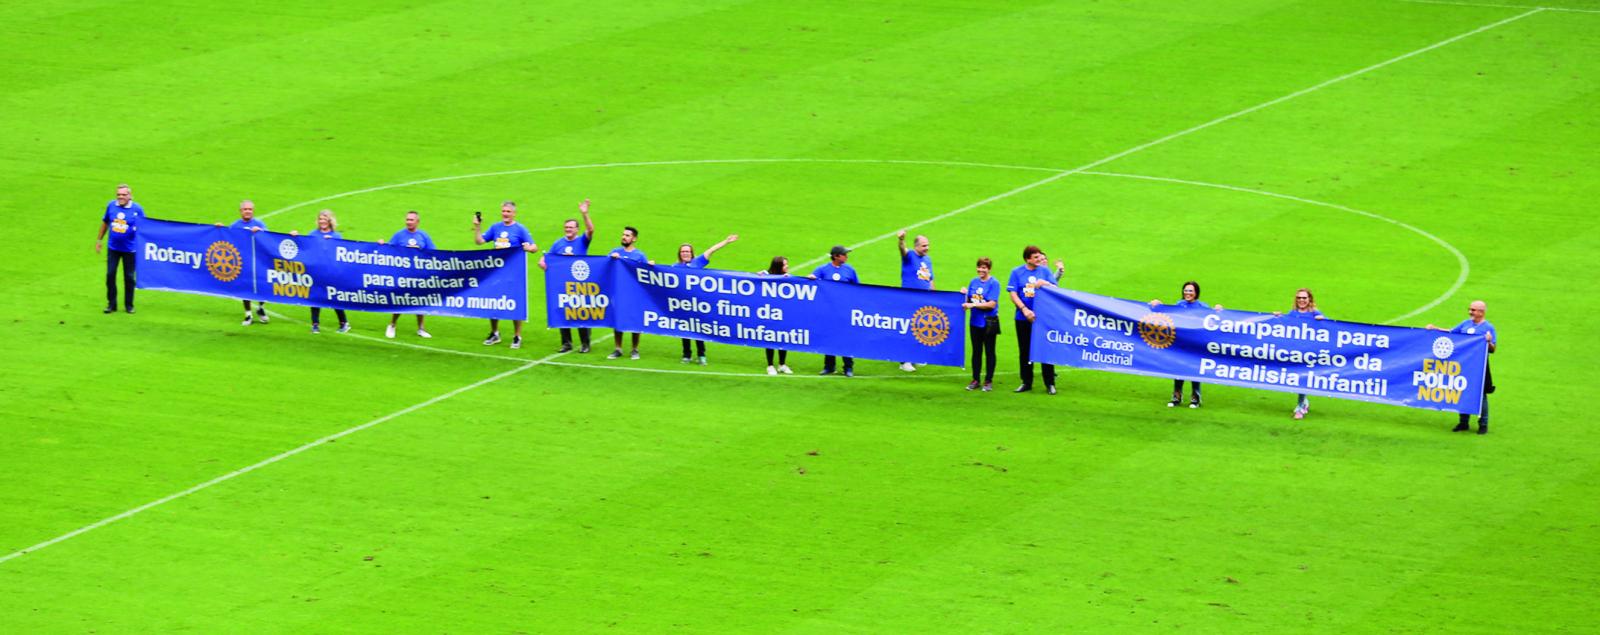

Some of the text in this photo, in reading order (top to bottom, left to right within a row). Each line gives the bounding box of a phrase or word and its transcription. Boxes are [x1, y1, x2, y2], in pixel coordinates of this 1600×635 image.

[145, 242, 202, 269] Rotary
[273, 258, 305, 275] END
[336, 246, 504, 271] Rotarianos trabalhando
[266, 269, 313, 287] POLIO
[363, 273, 478, 289] para erradicar a
[565, 281, 600, 296] END
[636, 268, 817, 300] END POLIO NOW
[272, 283, 310, 299] NOW
[326, 286, 516, 311] Paralisia Infantil no mundo
[558, 293, 609, 308] POLIO
[565, 307, 605, 320] NOW
[668, 296, 783, 321] pelo fim da
[643, 311, 810, 346] Paralisia Infantil
[851, 309, 910, 335] Rotary
[1074, 308, 1134, 336] Rotary
[1203, 314, 1389, 349] Campanha para
[1046, 329, 1134, 352] Club de Canoas
[1082, 349, 1133, 366] Industrial
[1207, 341, 1382, 372] erradicação da
[1422, 358, 1461, 376] END
[1199, 358, 1387, 396] Paralisia Infantil
[1412, 371, 1468, 391] POLIO
[1417, 386, 1462, 404] NOW
